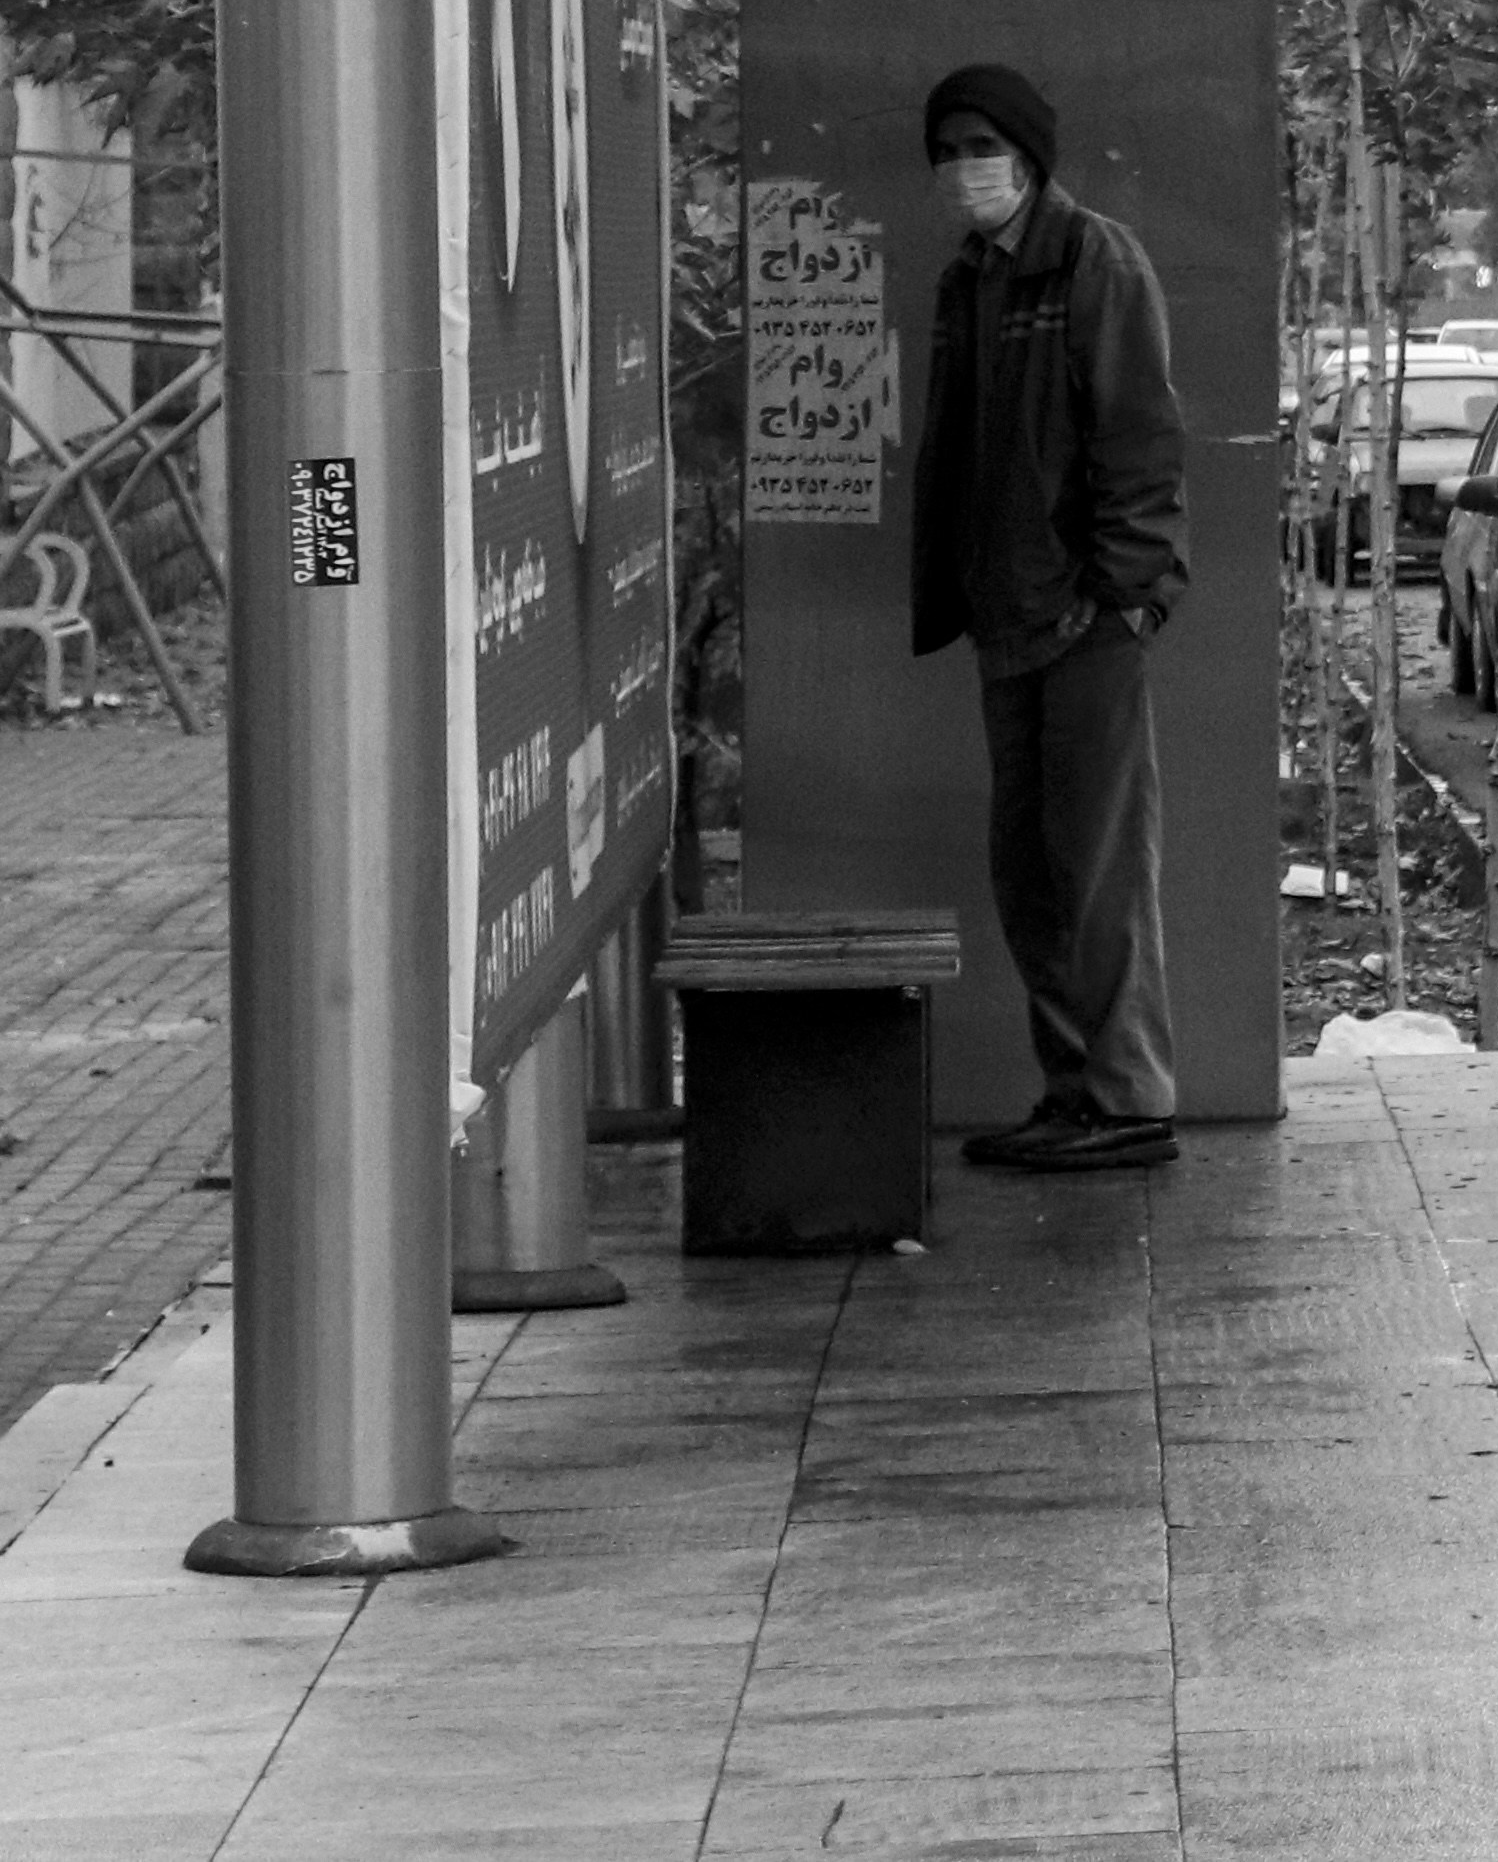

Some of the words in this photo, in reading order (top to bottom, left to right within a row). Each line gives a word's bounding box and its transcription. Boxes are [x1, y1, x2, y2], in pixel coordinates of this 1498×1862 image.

[760, 239, 872, 282] ازدواج
[789, 344, 843, 388] وام
[759, 395, 871, 441] ازدواج
[322, 462, 355, 537] ازدواج
[326, 543, 355, 578] وام
